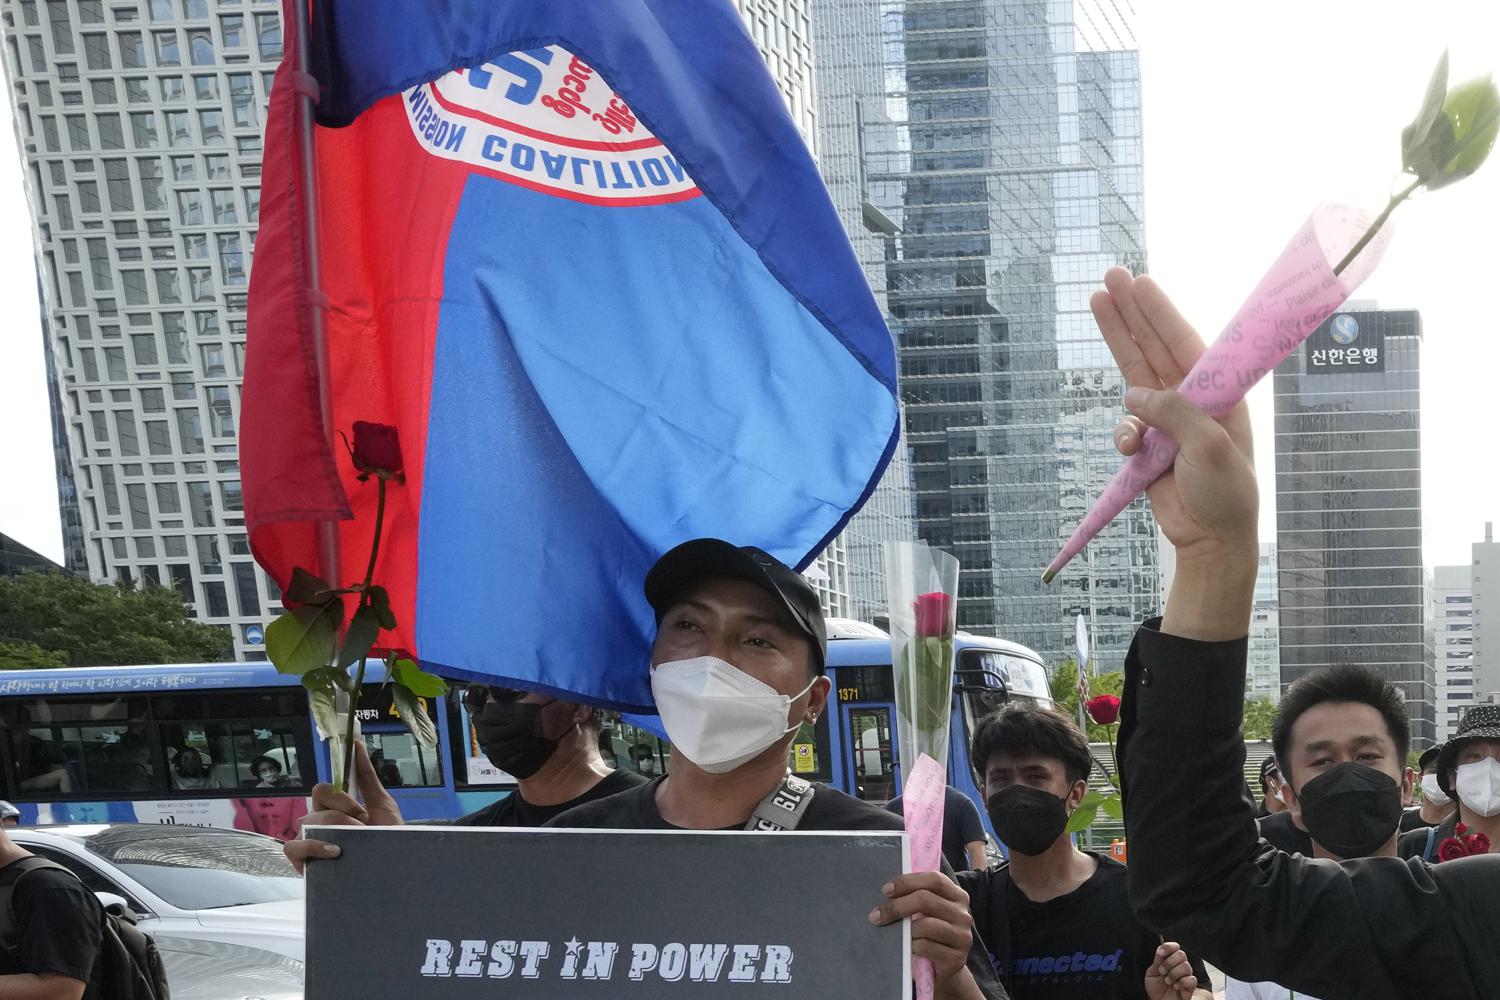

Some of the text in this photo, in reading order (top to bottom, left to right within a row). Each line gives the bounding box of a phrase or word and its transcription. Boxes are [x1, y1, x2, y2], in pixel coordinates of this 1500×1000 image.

[1311, 347, 1378, 366] 신한은행
[838, 688, 860, 701] 1371
[420, 939, 551, 979] REST
[628, 942, 794, 984] POWER
